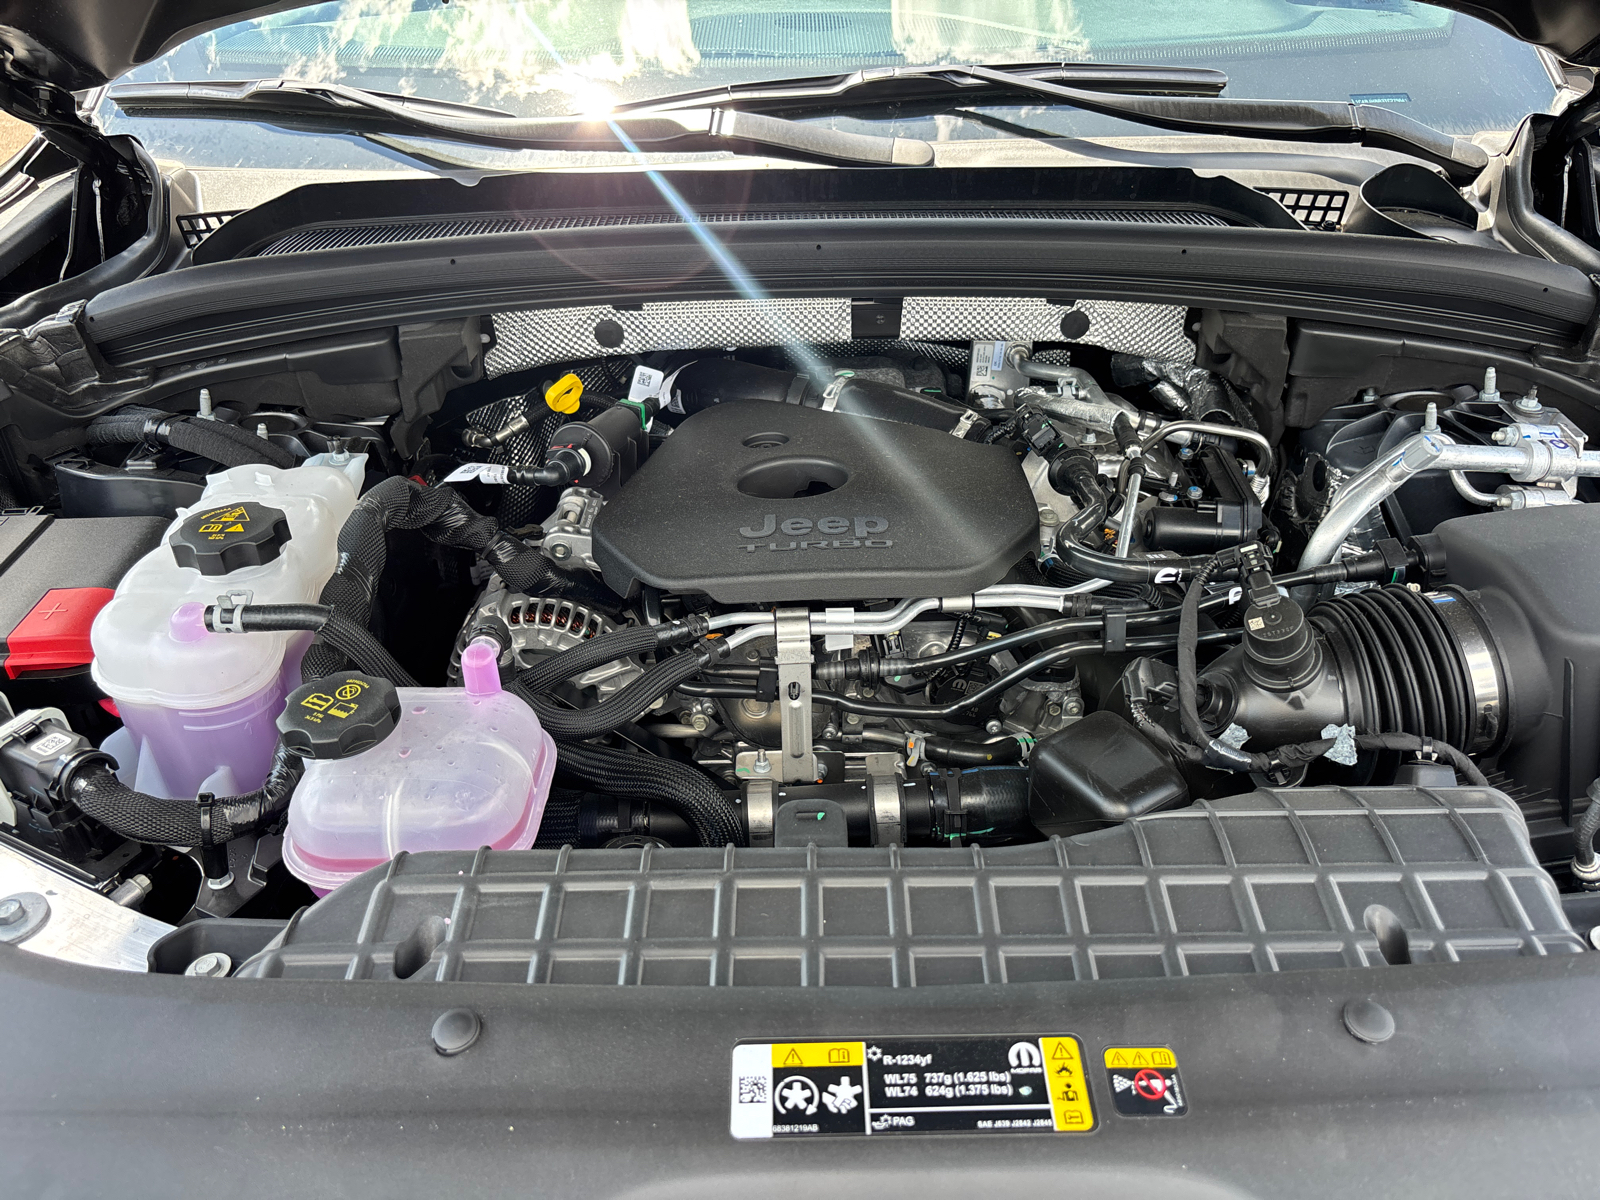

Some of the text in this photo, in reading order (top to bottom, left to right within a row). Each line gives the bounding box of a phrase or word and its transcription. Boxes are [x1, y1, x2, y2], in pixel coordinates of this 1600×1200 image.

[739, 514, 889, 538] Jeep
[737, 539, 893, 553] TURBO
[883, 1054, 932, 1067] R-1234yf
[884, 1071, 1011, 1085] WL75 737g (1.625 lbs)
[885, 1084, 1013, 1098] WL74 624g (1.375 lbs)
[893, 1116, 915, 1127] PAG
[977, 1120, 992, 1129] SAE
